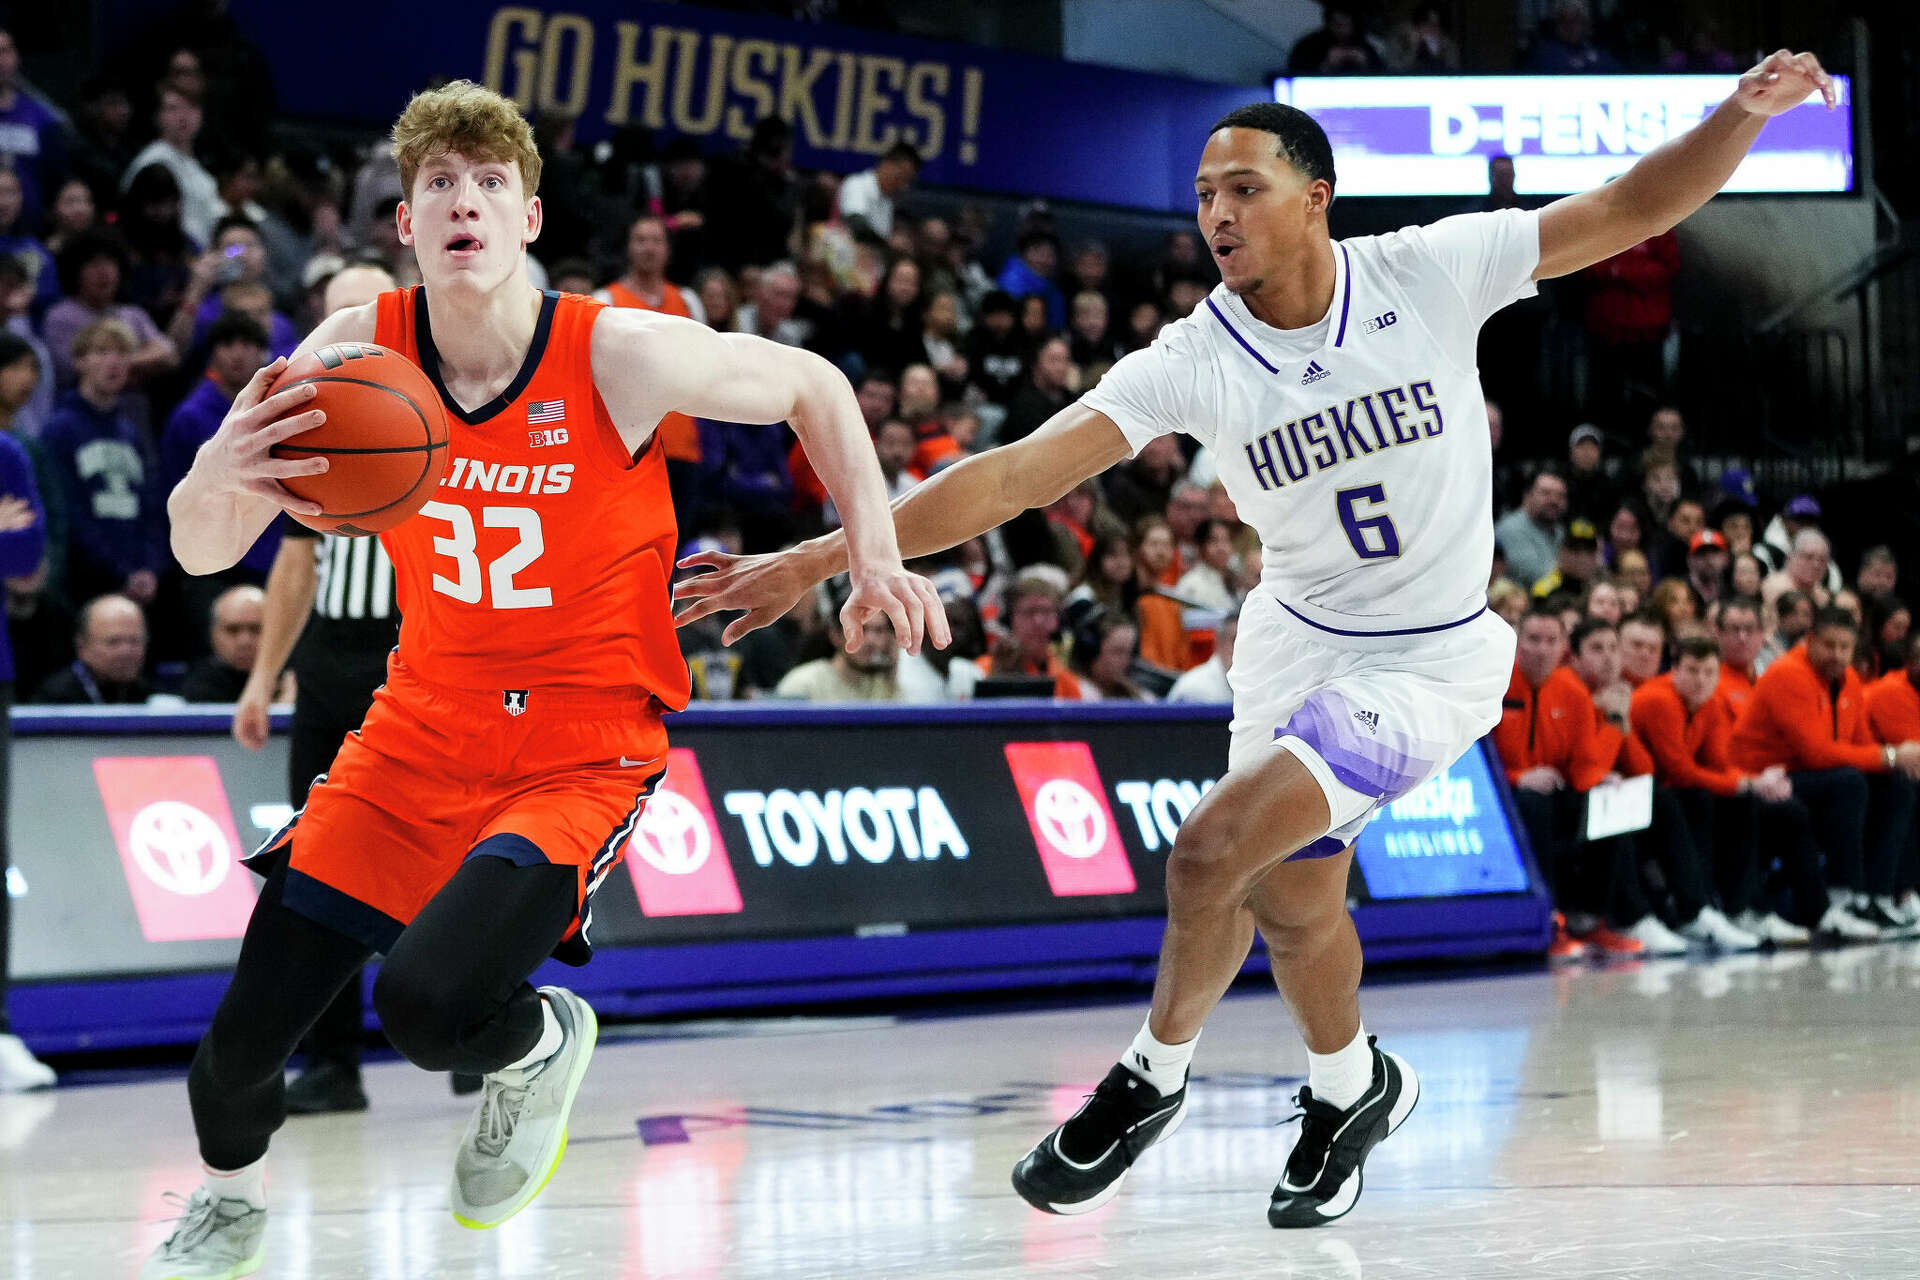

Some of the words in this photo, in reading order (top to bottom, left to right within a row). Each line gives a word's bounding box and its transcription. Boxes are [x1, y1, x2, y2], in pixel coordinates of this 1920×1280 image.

[483, 7, 595, 119] GO
[1301, 369, 1331, 385] adidas
[1244, 379, 1444, 490] HUSKIES
[439, 457, 575, 495] INOIS
[418, 500, 553, 609] 32
[1335, 481, 1402, 560] 6
[723, 786, 970, 867] TOYOTA
